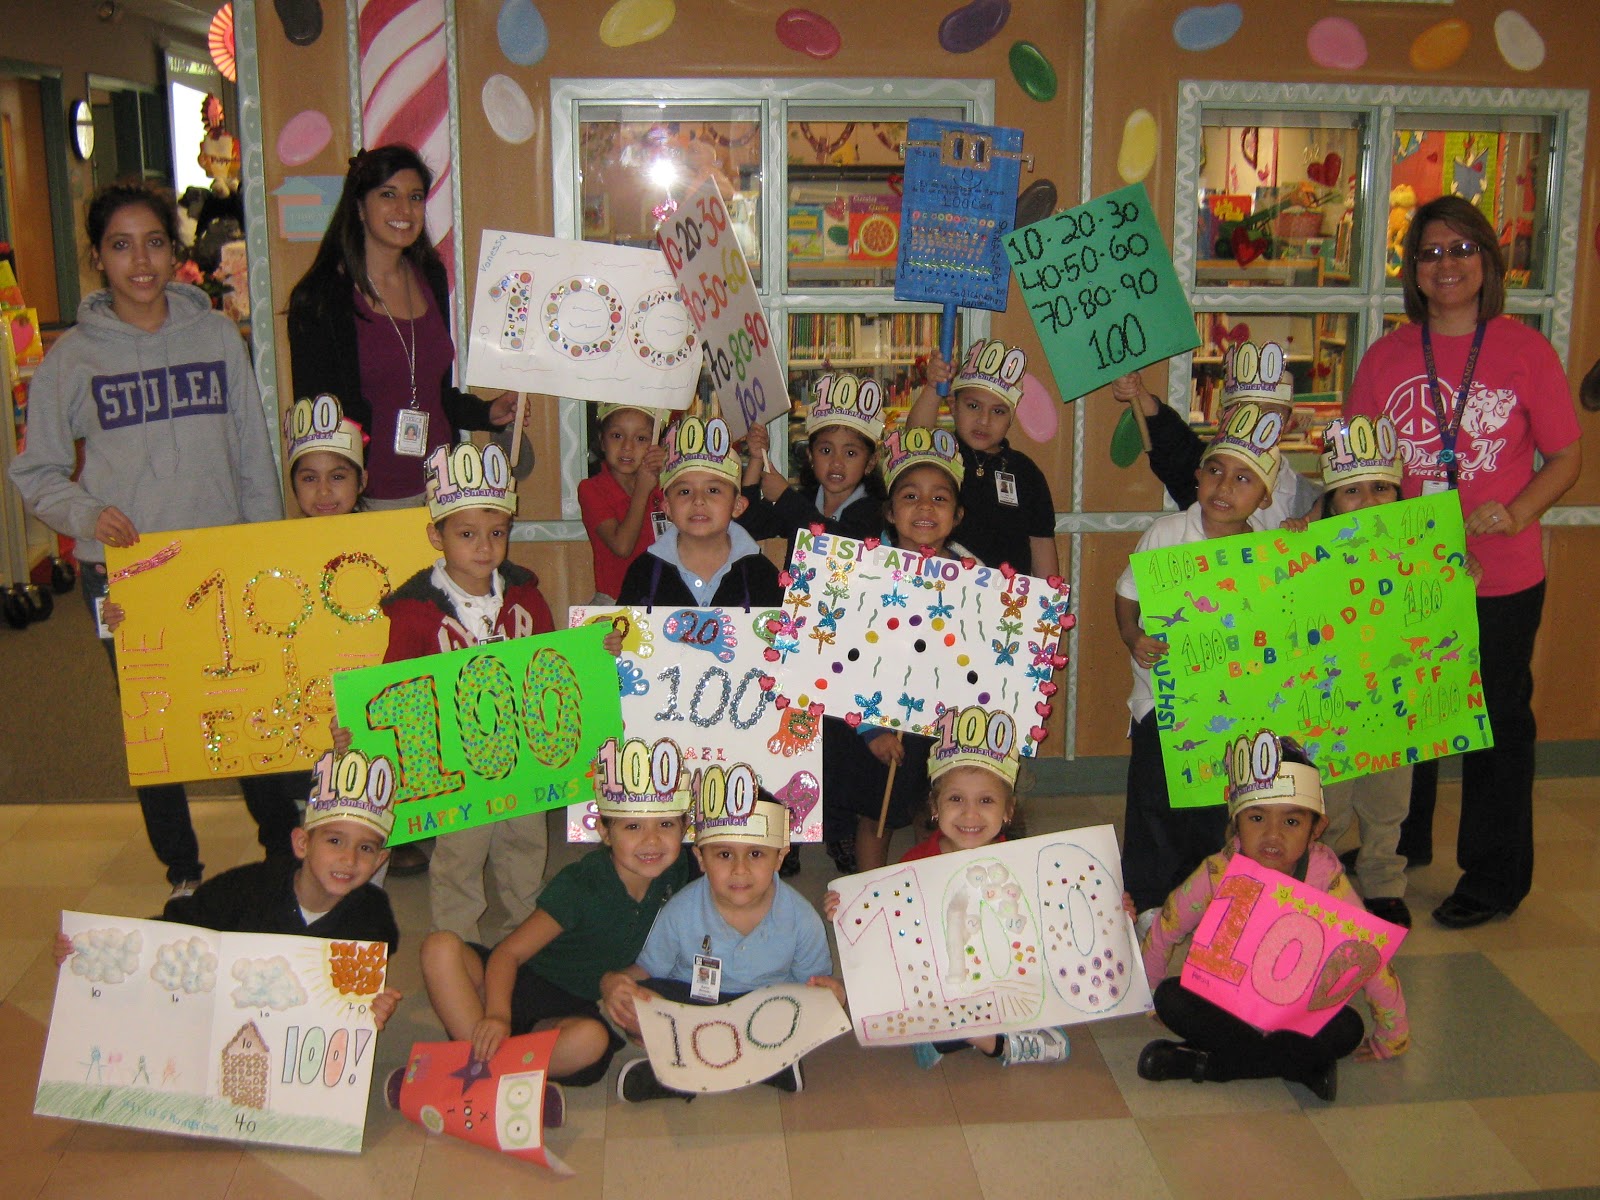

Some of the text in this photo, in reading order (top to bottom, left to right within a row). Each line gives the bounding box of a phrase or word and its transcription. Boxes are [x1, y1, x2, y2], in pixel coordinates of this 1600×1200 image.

[488, 269, 701, 371] 100
[1088, 313, 1147, 370] 100
[963, 339, 1027, 384] 100
[1223, 341, 1285, 386] 100
[284, 393, 342, 445] 100
[813, 373, 882, 417] 100
[662, 416, 731, 466] 100
[884, 427, 959, 465] 100
[1216, 402, 1284, 450] 100
[1323, 415, 1399, 470] 100
[429, 441, 511, 500] 100
[1336, 460, 1358, 473] Days
[439, 487, 507, 505] Days Smarter!
[797, 531, 865, 562] KEISI
[873, 549, 960, 581] PATINO
[182, 551, 392, 681] 100
[680, 610, 719, 645] 20
[654, 664, 769, 730] 100
[366, 647, 583, 804] 100
[936, 704, 1017, 758] 100
[313, 748, 397, 809] 100
[599, 736, 684, 796] 100
[961, 746, 1005, 763] Smarter!
[1224, 728, 1283, 790] 100
[314, 796, 383, 817] Days Smarter!
[407, 778, 580, 834] HAPPY 100 DAYS
[606, 790, 674, 804] Days Smarter!
[691, 762, 759, 823] 100
[838, 843, 1134, 1041] 100
[1185, 873, 1382, 1012] 100
[281, 1026, 373, 1088] 100!
[656, 995, 802, 1069] 100
[235, 1113, 257, 1134] 40
